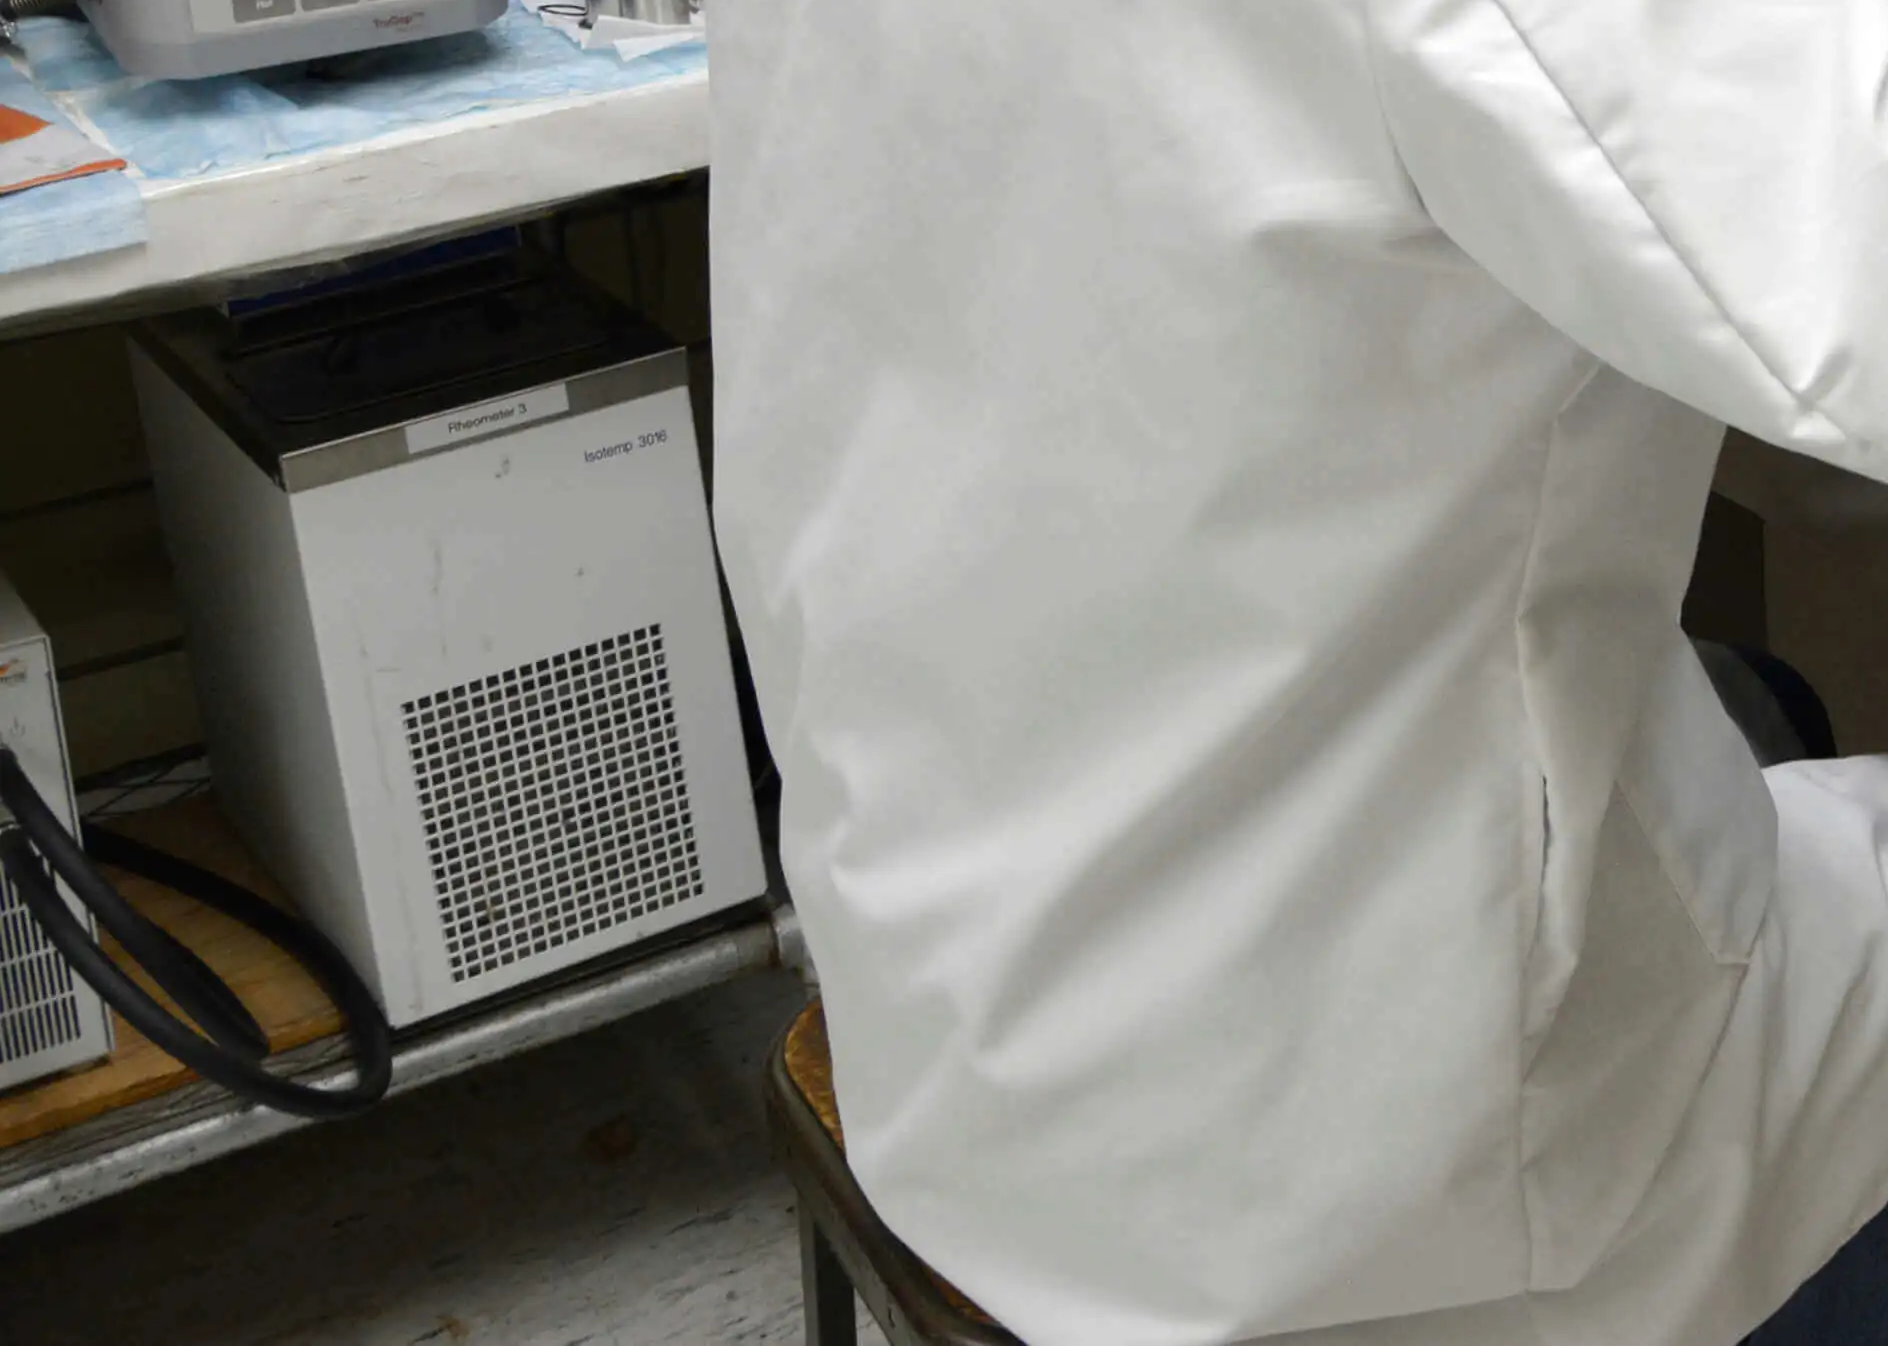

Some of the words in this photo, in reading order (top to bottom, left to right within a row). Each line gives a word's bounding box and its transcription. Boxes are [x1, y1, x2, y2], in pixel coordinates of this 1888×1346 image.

[448, 408, 515, 434] Rheometer
[519, 403, 527, 414] 3
[584, 439, 634, 463] Isotemp
